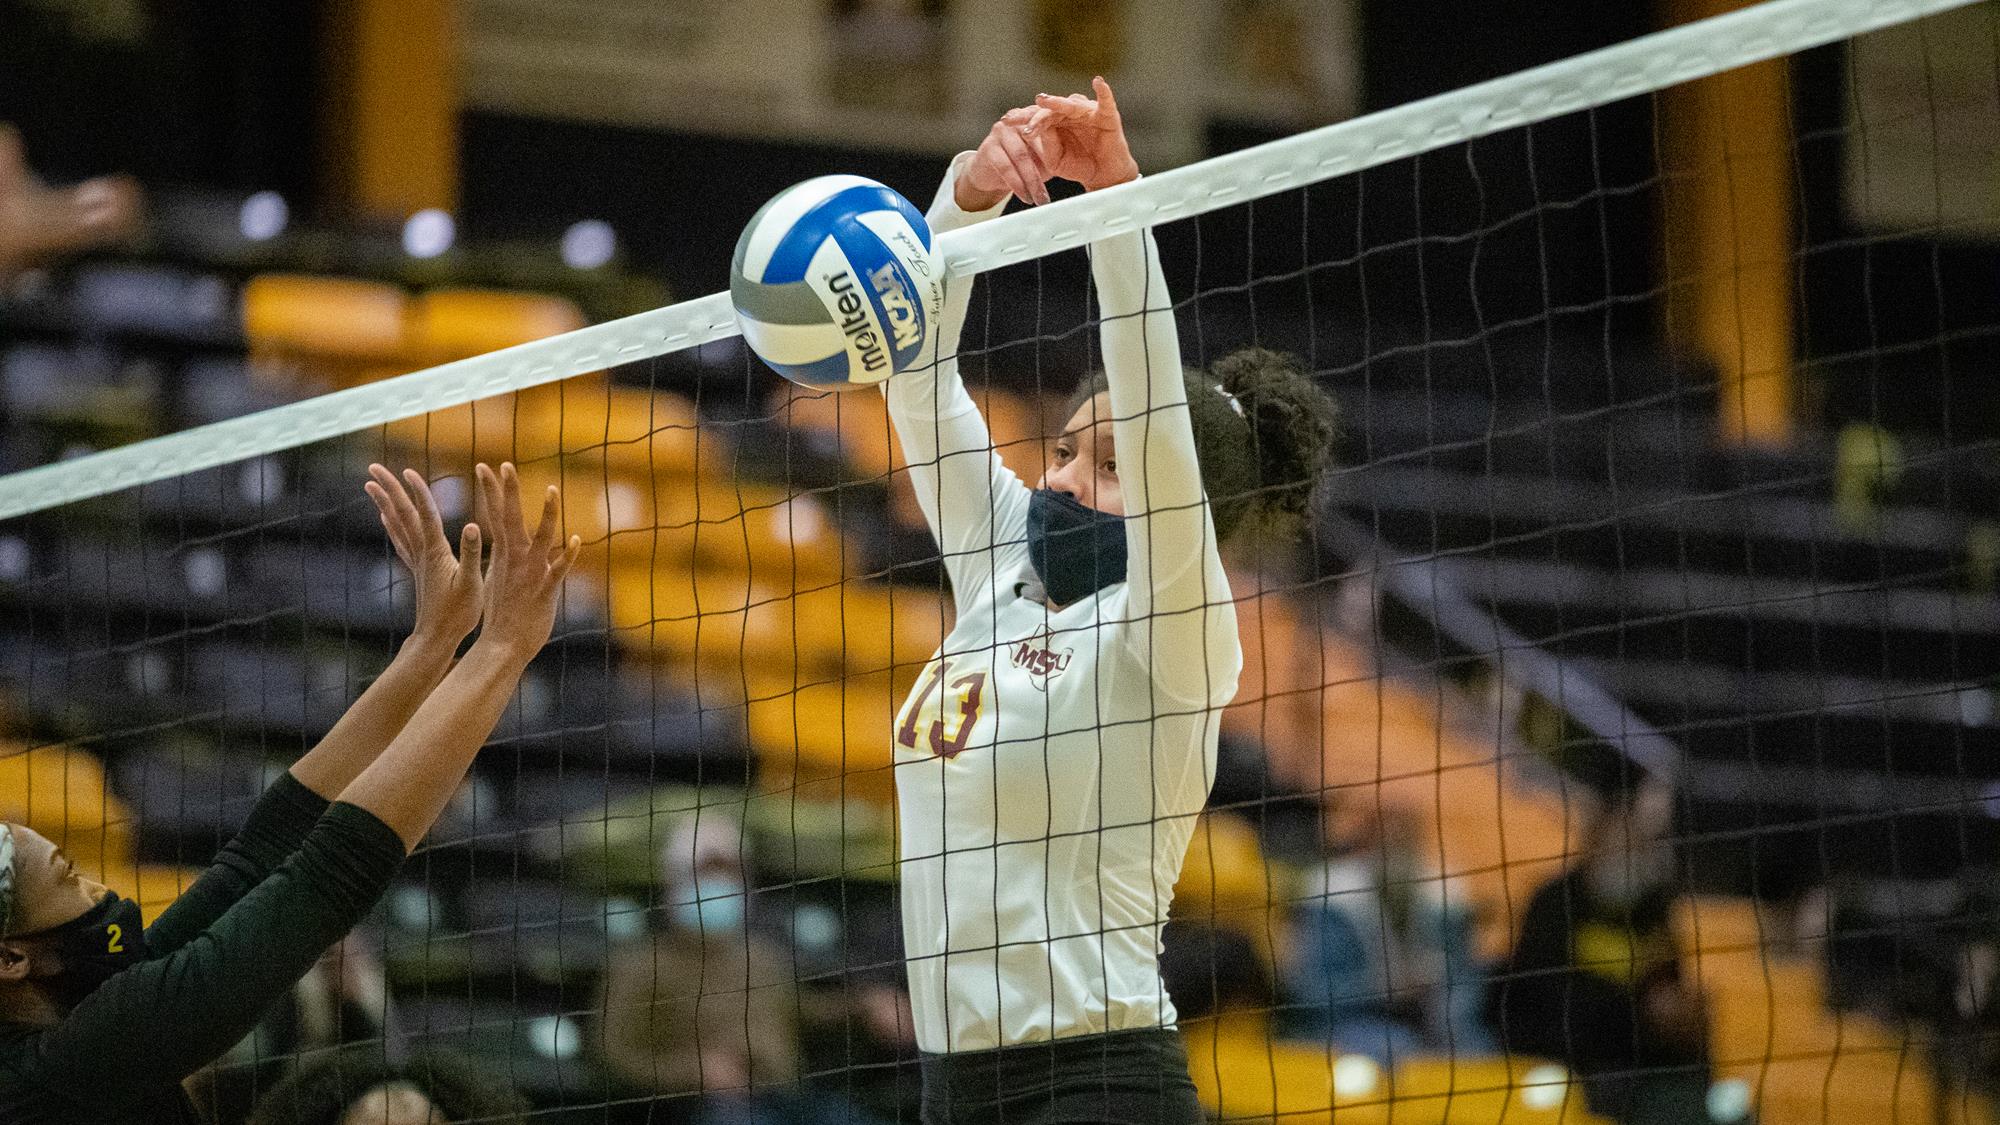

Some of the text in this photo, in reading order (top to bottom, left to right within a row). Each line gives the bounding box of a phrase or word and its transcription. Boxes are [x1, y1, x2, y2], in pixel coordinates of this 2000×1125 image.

[893, 231, 930, 278] Touch
[828, 271, 887, 372] molten
[870, 261, 920, 350] NCAA
[1013, 642, 1072, 675] MSU
[898, 661, 986, 760] 13
[106, 923, 124, 954] 2
